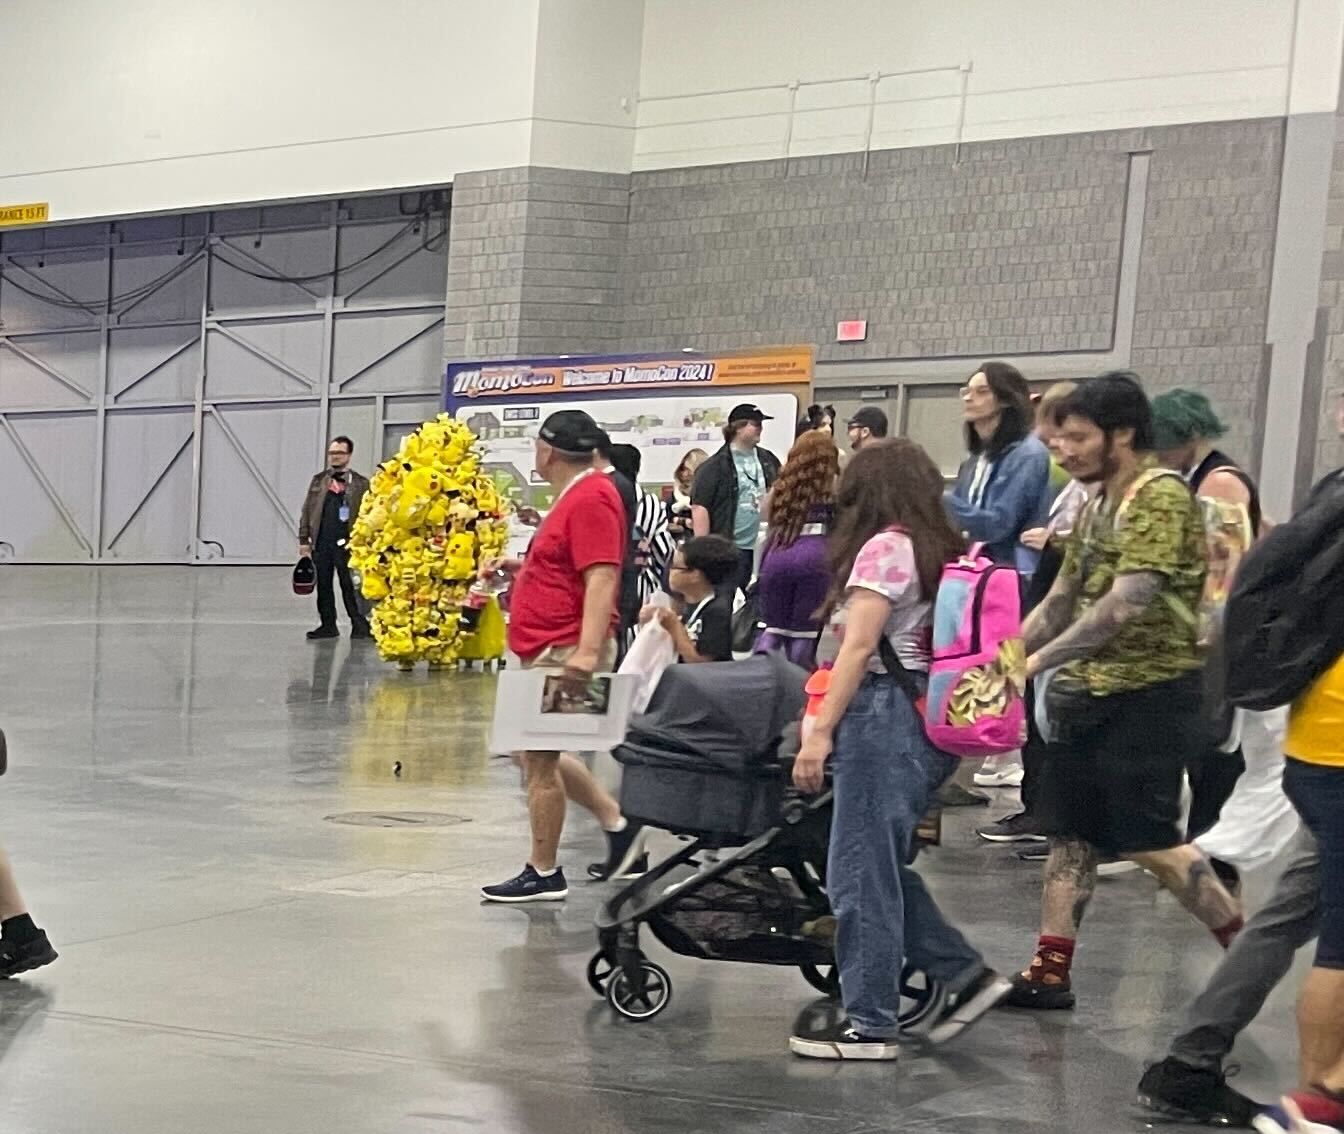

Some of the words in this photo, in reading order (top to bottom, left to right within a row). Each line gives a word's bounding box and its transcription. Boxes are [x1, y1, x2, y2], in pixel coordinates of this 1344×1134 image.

[452, 369, 555, 395] MomoCon
[562, 368, 611, 387] Welcome
[623, 365, 680, 384] MomoCon
